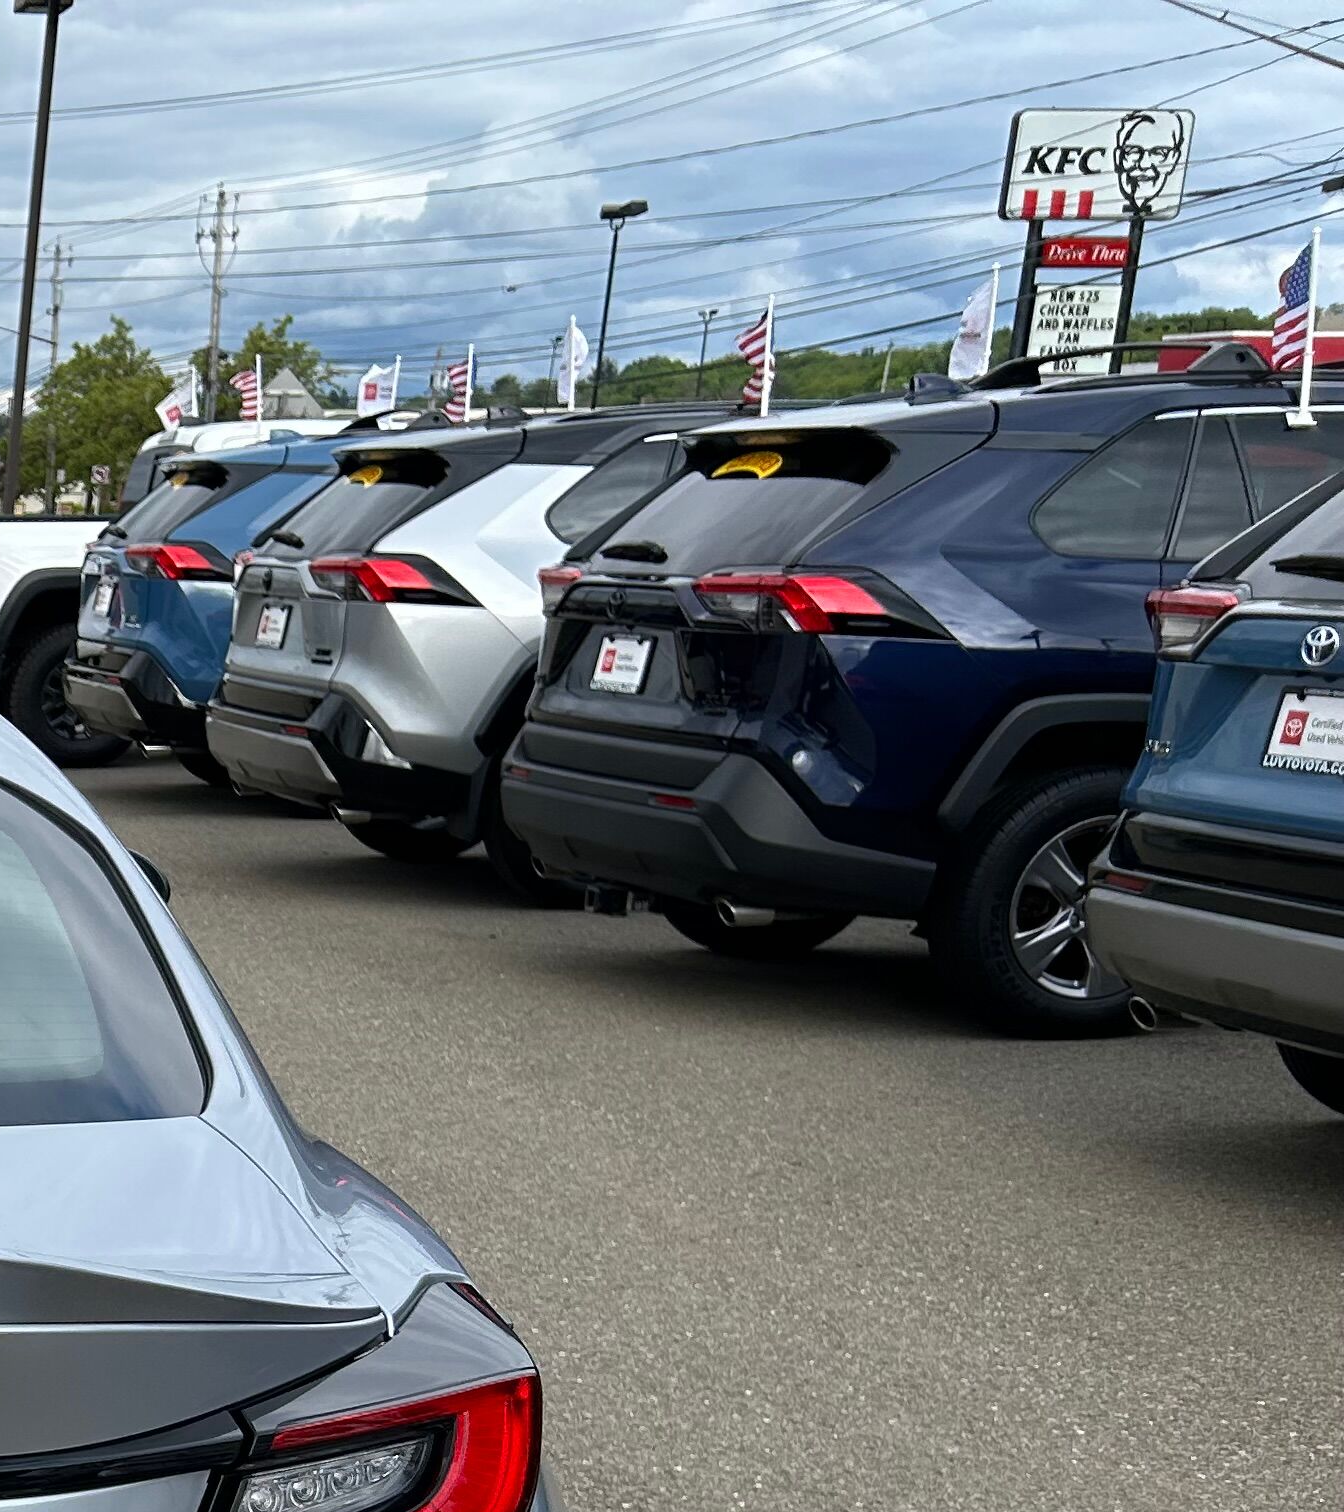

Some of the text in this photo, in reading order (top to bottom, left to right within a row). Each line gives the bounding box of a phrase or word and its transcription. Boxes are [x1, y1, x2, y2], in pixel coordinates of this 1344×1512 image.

[1022, 146, 1106, 175] KFC
[1048, 244, 1127, 261] Drive Thru
[1050, 289, 1075, 303] NEW
[1039, 304, 1090, 318] CHICKEN
[1037, 318, 1114, 331] AND WAFFLES
[1058, 332, 1080, 344] FAN
